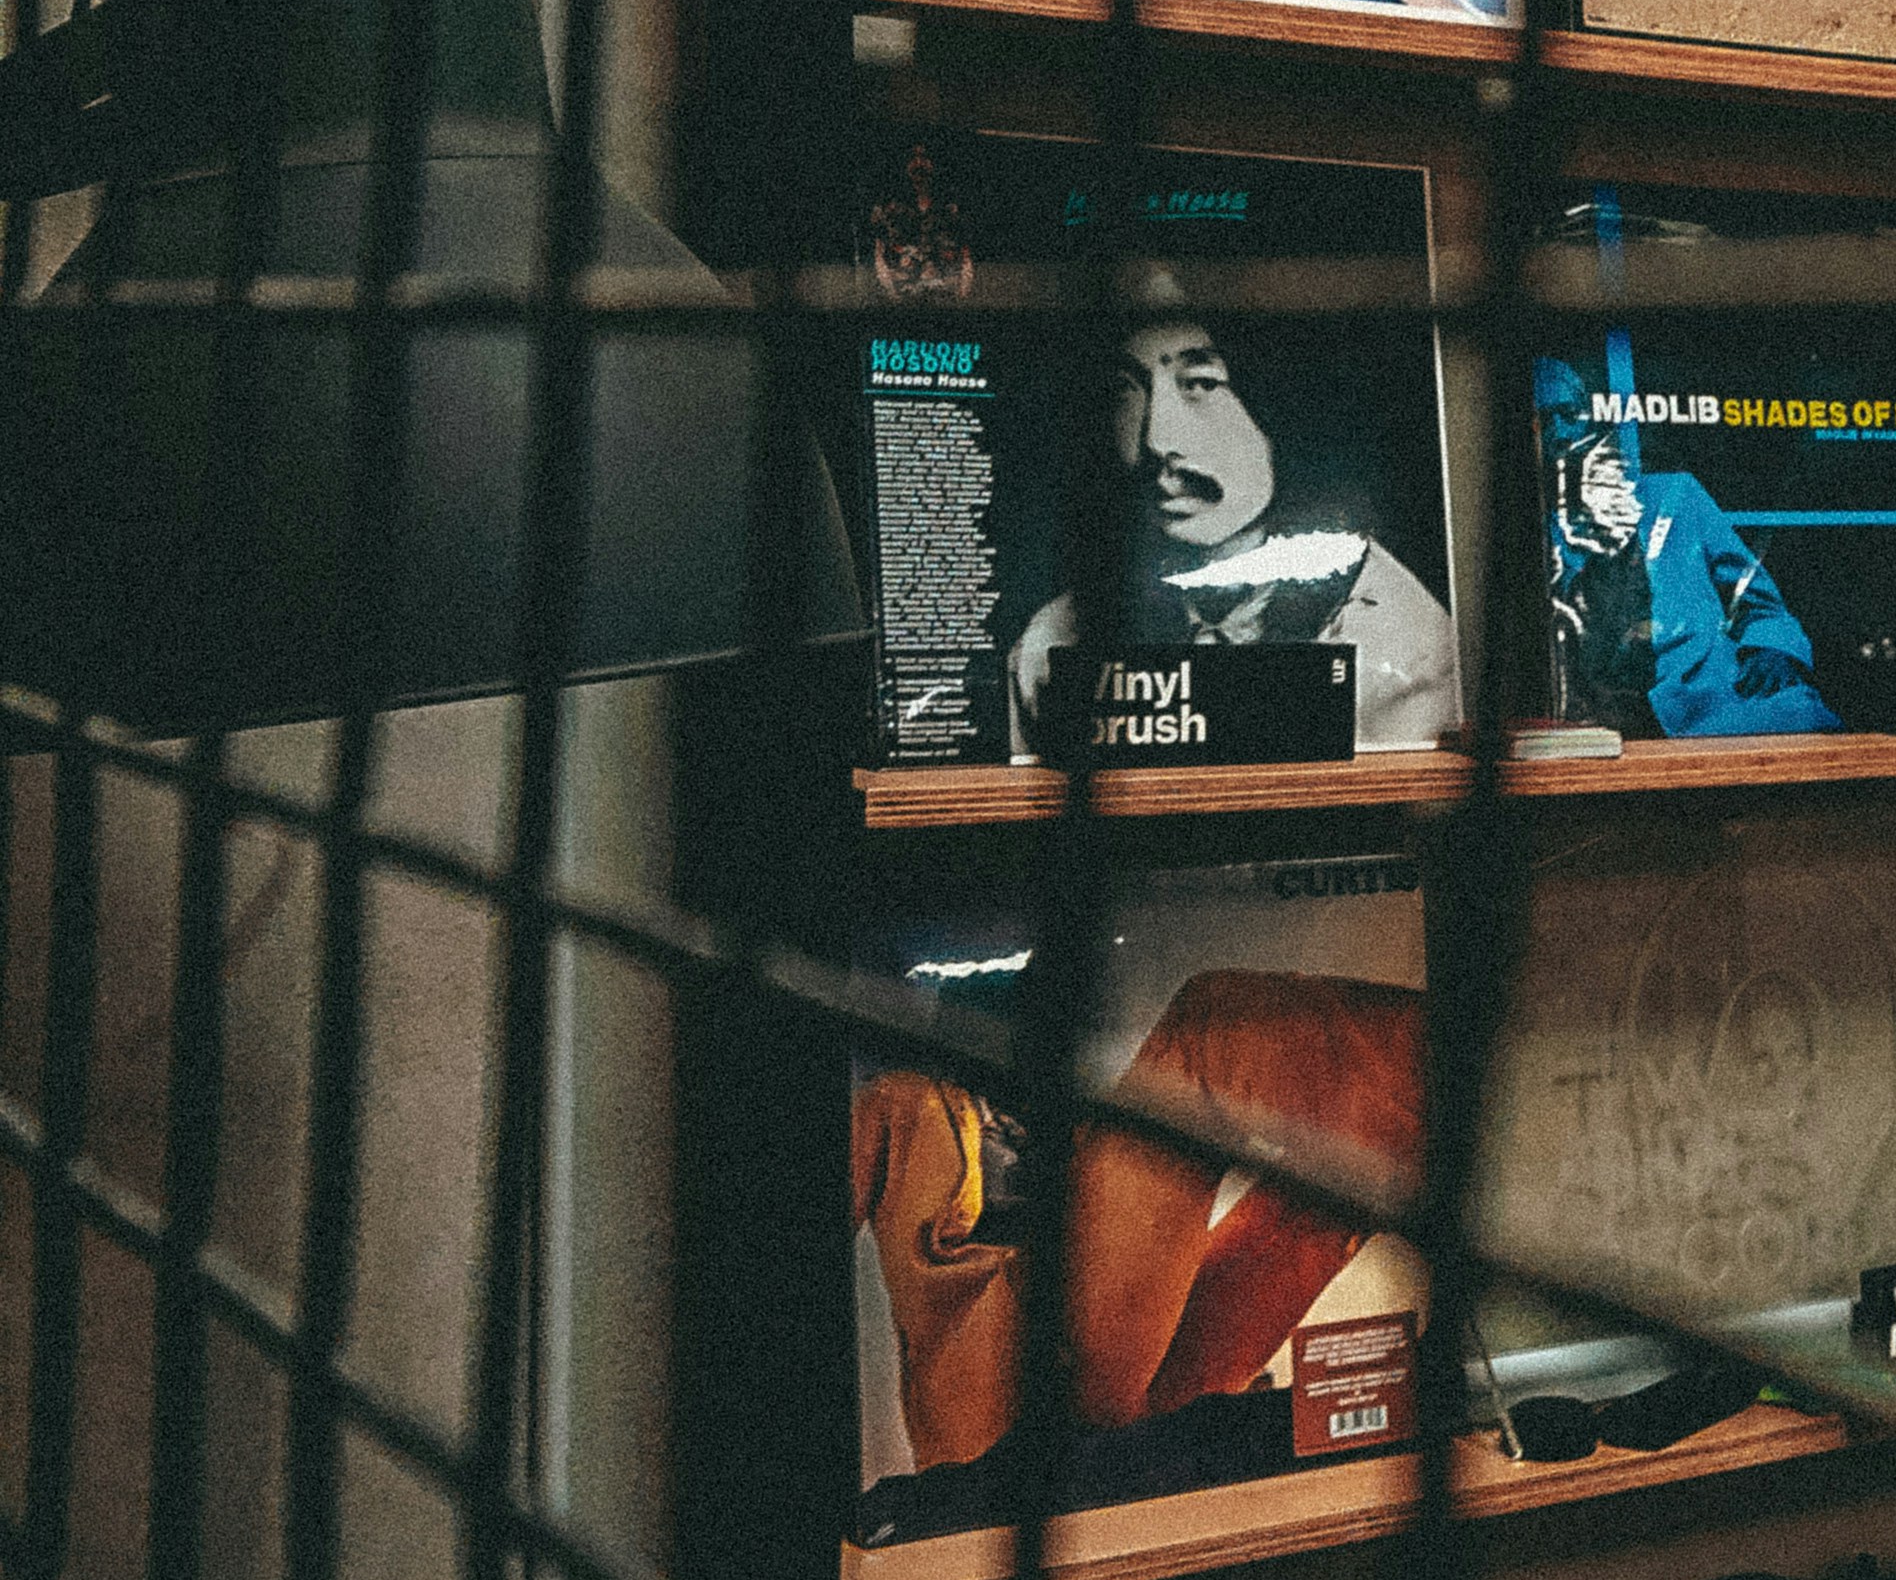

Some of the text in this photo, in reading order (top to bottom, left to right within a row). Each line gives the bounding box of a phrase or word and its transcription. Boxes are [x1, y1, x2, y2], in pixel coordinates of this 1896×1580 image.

[870, 338, 982, 360] HARUOMI
[870, 352, 974, 374] HOSONO
[871, 371, 988, 388] Hosono House
[1592, 392, 1720, 424] MADLIB
[1723, 395, 1847, 428] SHADES
[1853, 400, 1891, 428] OF
[1092, 707, 1207, 745] rush
